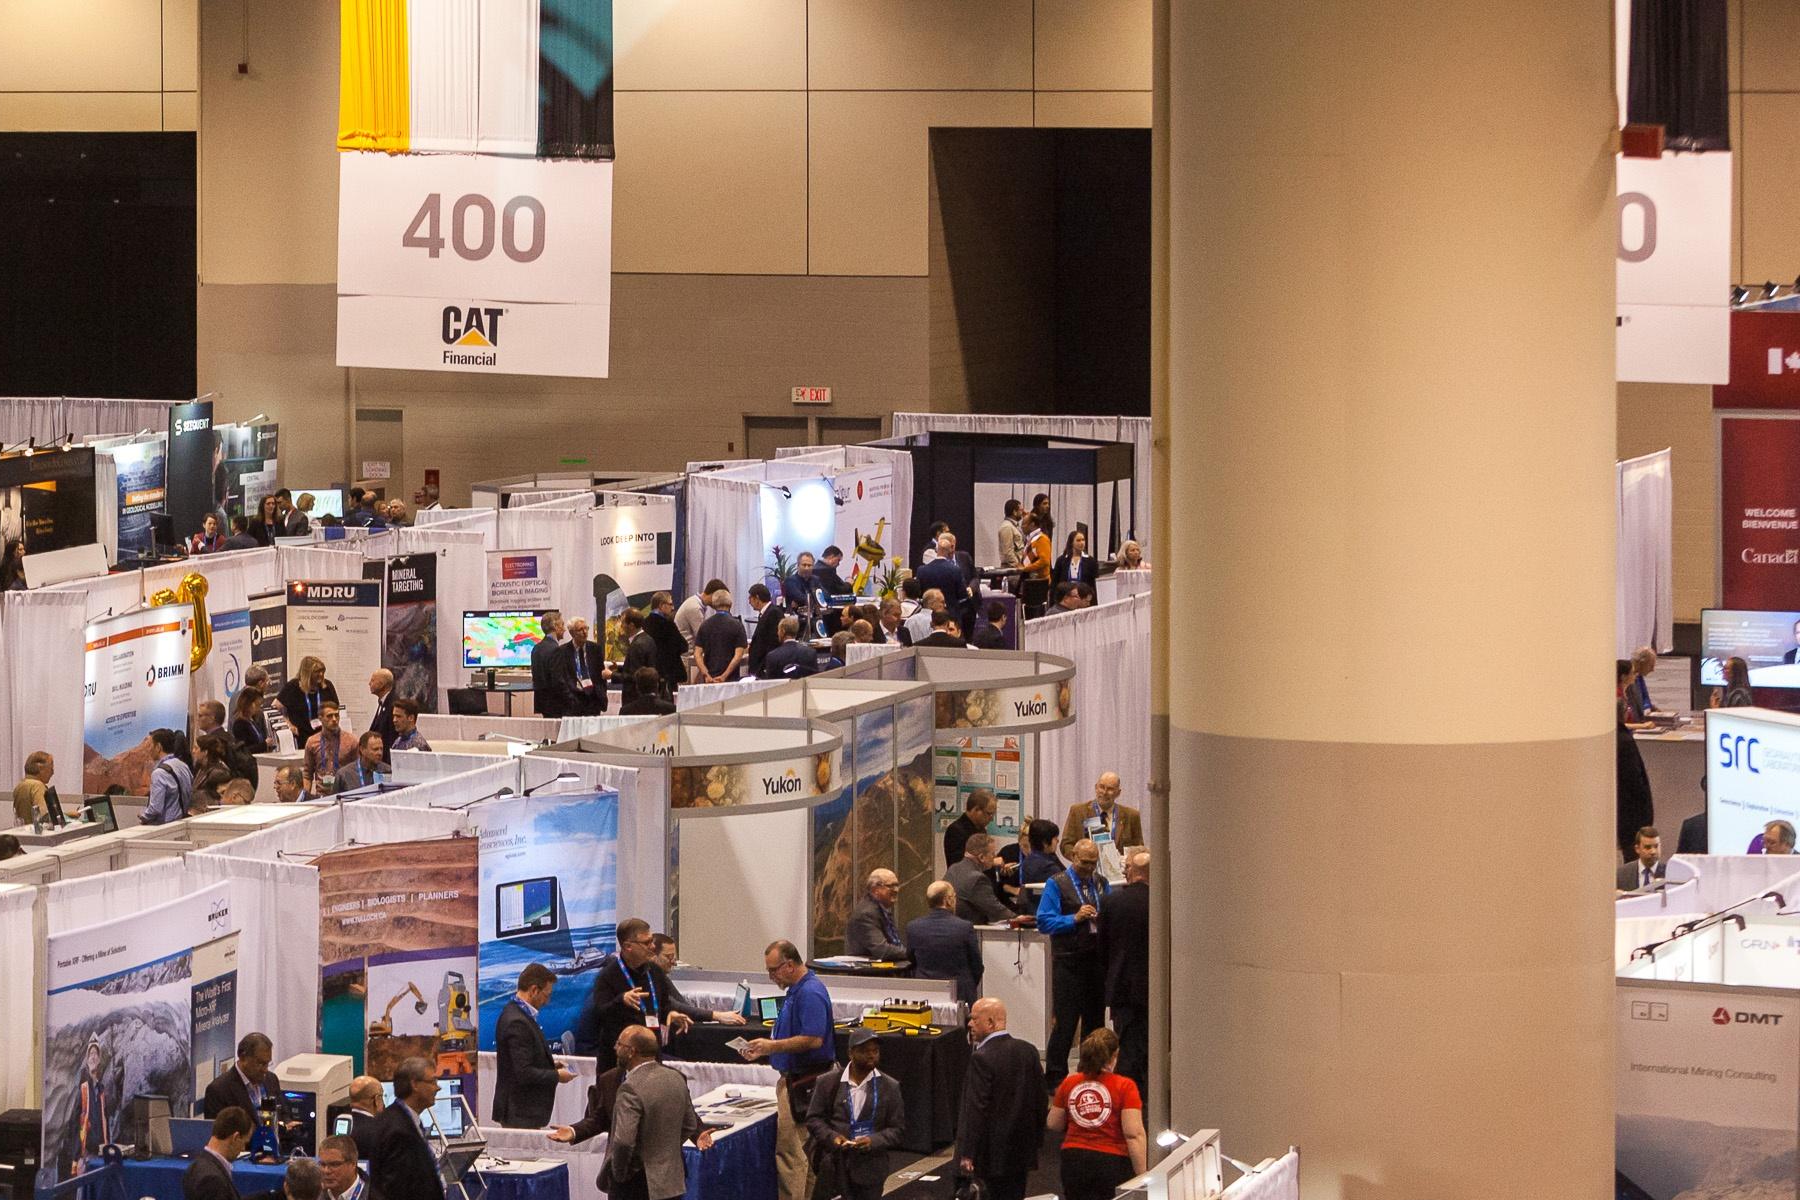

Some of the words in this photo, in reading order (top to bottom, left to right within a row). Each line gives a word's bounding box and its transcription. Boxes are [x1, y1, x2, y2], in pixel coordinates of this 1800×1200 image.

[402, 193, 546, 264] 400
[441, 305, 504, 347] CAT
[442, 350, 497, 367] Financial
[809, 388, 828, 402] EXIT
[1744, 508, 1797, 518] WELCOME
[1741, 520, 1799, 530] BIENVENUE
[600, 537, 614, 548] LOOK
[635, 532, 655, 543] INTO
[1741, 547, 1799, 565] Canada
[392, 567, 419, 581] MINERAL
[306, 586, 357, 600] MDRU
[392, 577, 424, 594] TARGETING
[261, 624, 284, 638] BRIMM
[325, 623, 339, 632] Teck
[157, 663, 184, 680] BRIMM
[1013, 698, 1048, 718] Yukon
[762, 774, 802, 796] Yukon
[331, 900, 362, 914] ENGINEERS
[366, 894, 407, 908] BIOLOGISTS
[417, 889, 460, 902] PLANNERS
[207, 907, 229, 923] BRUKER
[1734, 1011, 1783, 1026] DMT
[1630, 1061, 1690, 1076] International
[1690, 1066, 1722, 1080] Mining
[1722, 1068, 1779, 1085] Consulting
